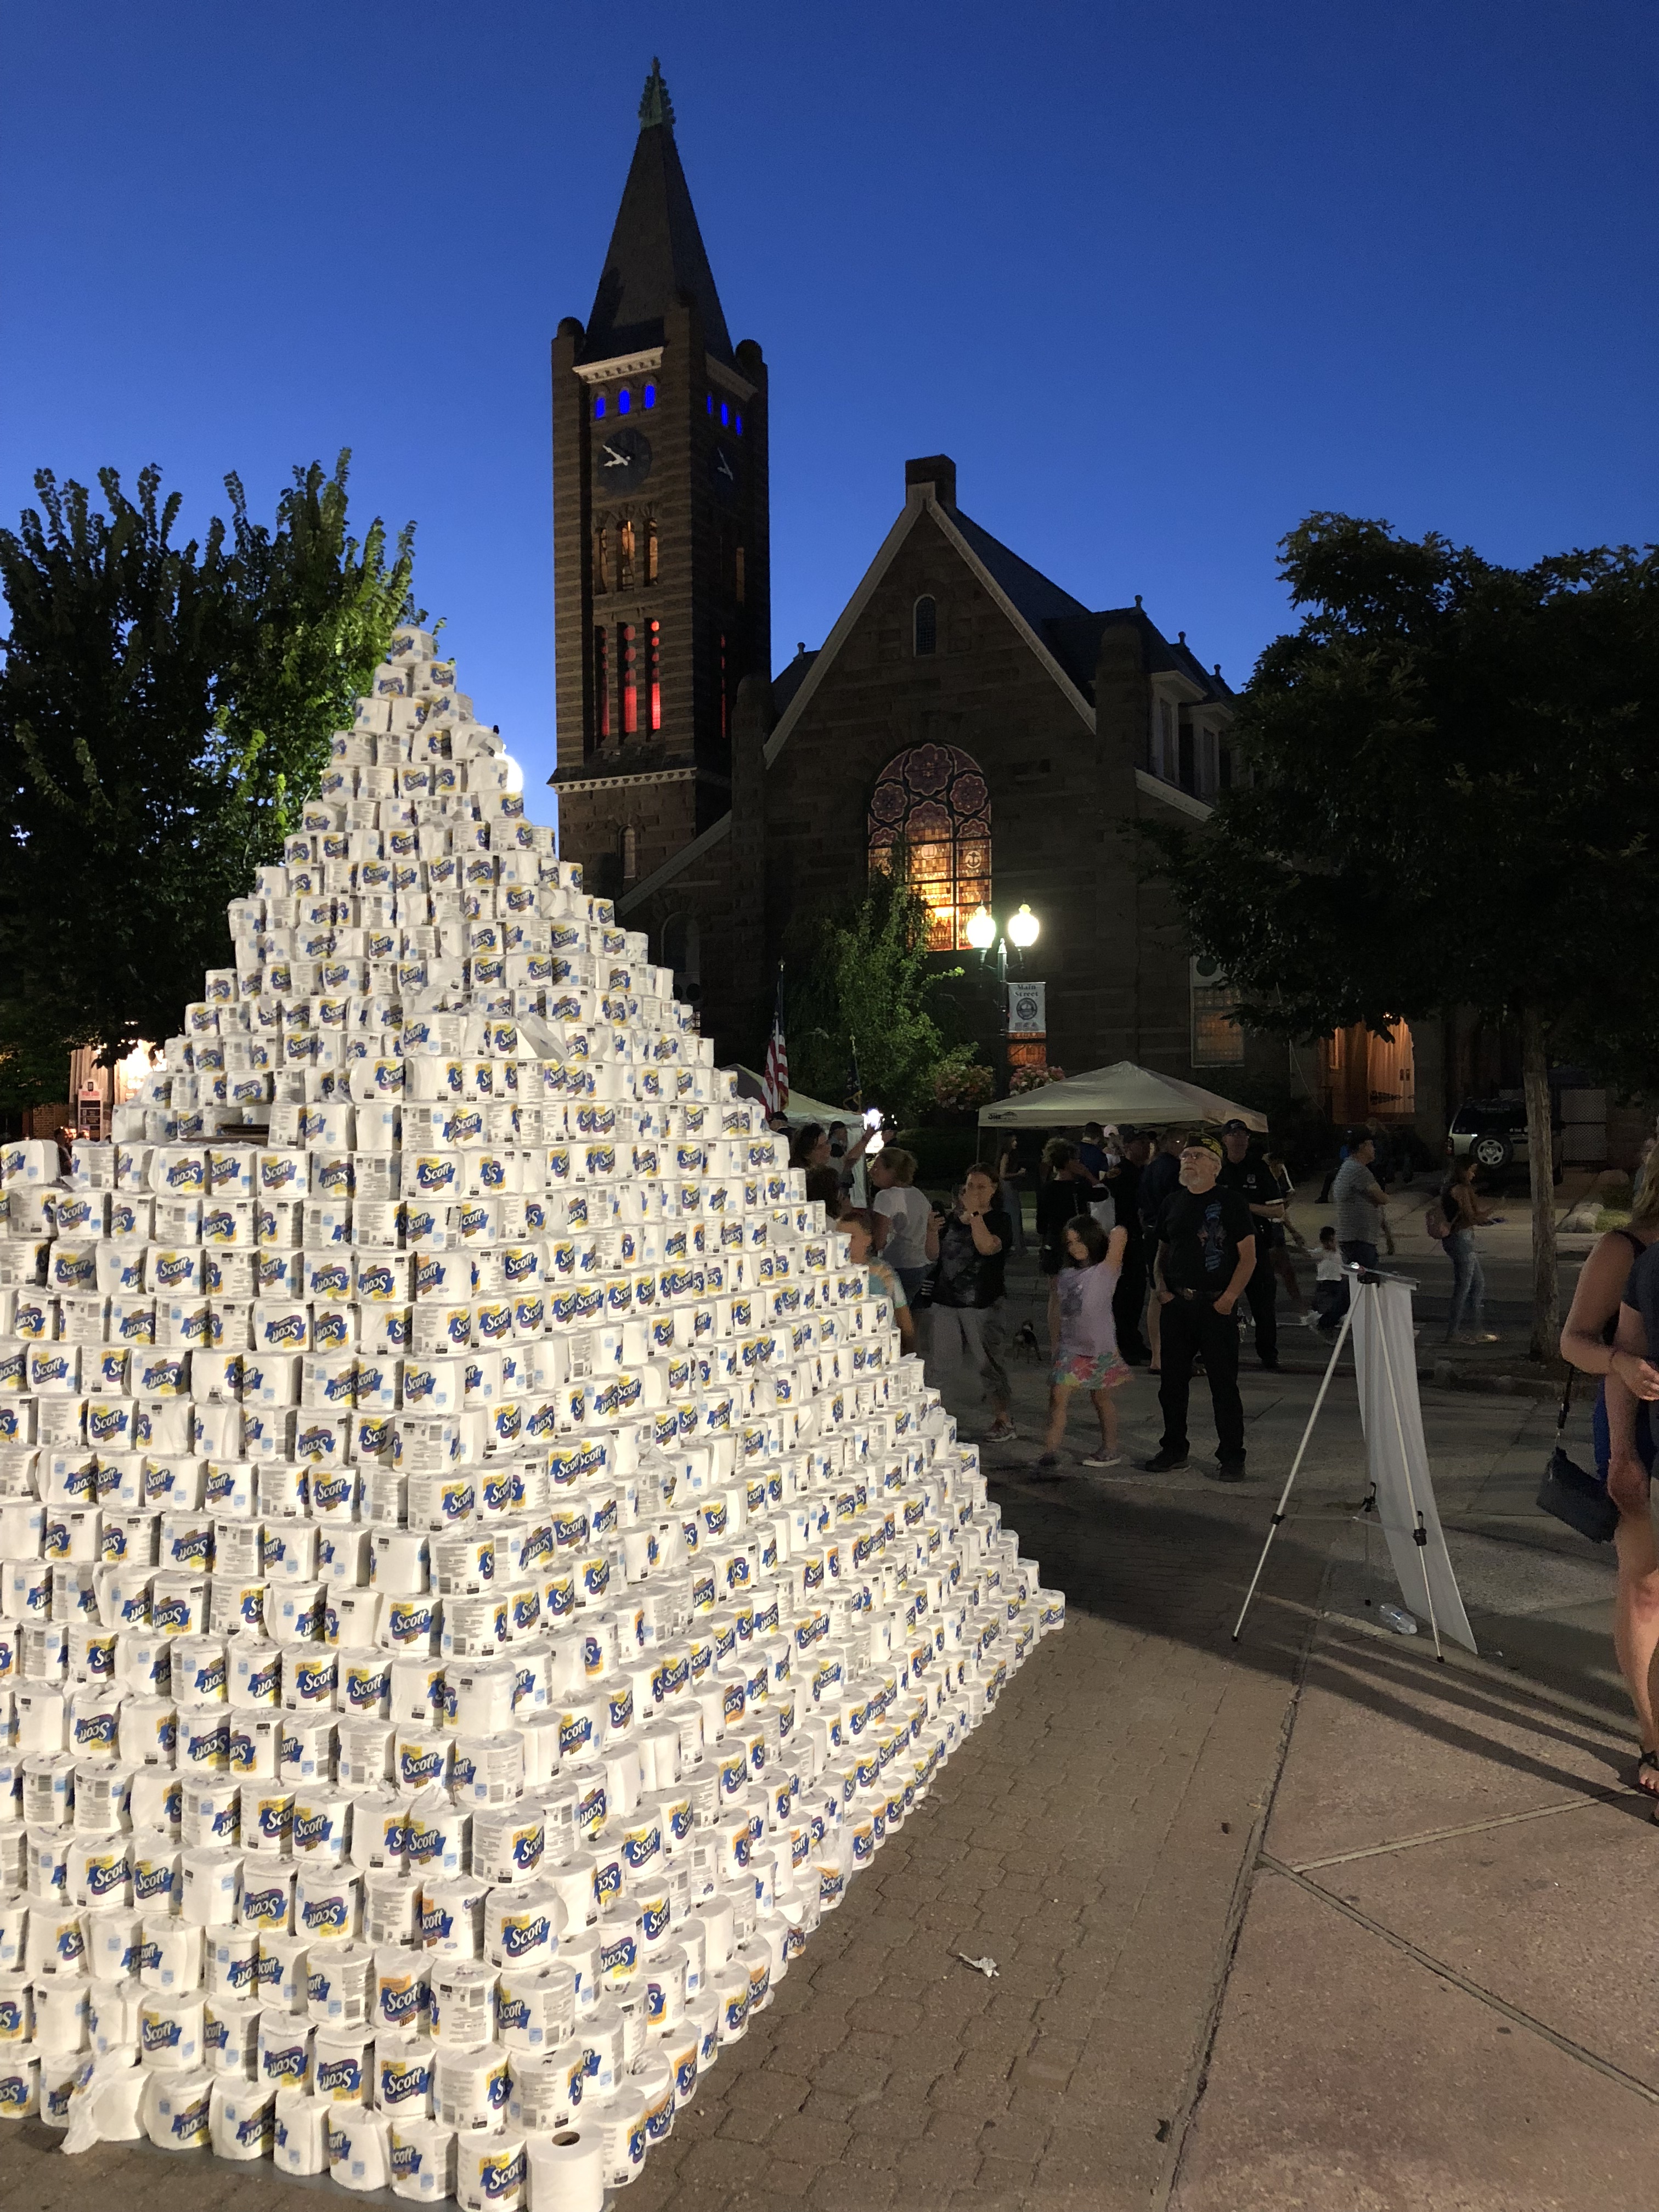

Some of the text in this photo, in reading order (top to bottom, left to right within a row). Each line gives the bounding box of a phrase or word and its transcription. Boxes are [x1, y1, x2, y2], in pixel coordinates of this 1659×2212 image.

[554, 928, 577, 944] Scott
[477, 961, 499, 976] Scott
[455, 1112, 478, 1132] Scott
[173, 1168, 198, 1188] Scott
[212, 1159, 234, 1178] Scott
[263, 1159, 290, 1181] Scott
[323, 1169, 349, 1189] Scott
[423, 1161, 450, 1183] Scott
[59, 1201, 85, 1222] Scott
[462, 1207, 483, 1226] cott
[58, 1257, 87, 1277] Scott
[160, 1257, 189, 1277] Scott
[506, 1252, 535, 1273] Scott
[315, 1273, 343, 1293] Scott
[363, 1274, 388, 1294] Scott
[577, 1288, 603, 1311] Scott
[126, 1319, 153, 1338] Scott
[486, 1307, 511, 1330] Scott
[271, 1321, 300, 1344] Scott
[315, 1322, 340, 1343] Scott
[34, 1359, 62, 1378] Scott
[149, 1369, 178, 1389] Scott
[671, 1362, 689, 1380] cott
[407, 1372, 430, 1391] Scott
[618, 1378, 640, 1398] Scott
[94, 1409, 121, 1431] Scott
[533, 1412, 554, 1436] Scott
[656, 1417, 676, 1439] Scott
[300, 1436, 329, 1457] Scott
[746, 1430, 763, 1448] cott
[560, 1454, 580, 1478] Scott
[580, 1445, 603, 1466] Scott
[147, 1469, 170, 1488] Scott
[207, 1473, 229, 1492] Scott
[317, 1479, 345, 1500] Scott
[452, 1486, 472, 1512] Scott
[748, 1484, 764, 1503] cott
[558, 1514, 585, 1540] Scott
[178, 1539, 207, 1561] Scott
[155, 1607, 183, 1626] Scott
[394, 1609, 427, 1632] Scott
[692, 1646, 711, 1668] cott
[303, 1666, 336, 1691] Scott
[665, 1658, 690, 1686] Scott
[353, 1674, 384, 1697] Scott
[79, 1722, 110, 1742] Scott
[561, 1717, 586, 1743] Scott
[194, 1735, 228, 1760] Scott
[404, 1753, 437, 1776] Scott
[580, 1795, 605, 1829] Scott
[296, 1816, 325, 1838] Scott
[409, 1829, 438, 1851] Scott
[633, 1827, 658, 1860] Scott
[138, 1867, 166, 1891] Scott
[247, 1897, 279, 1918] Scott
[307, 1905, 341, 1927] Scott
[423, 1909, 443, 1929] cott
[509, 1916, 546, 1949] Scott
[386, 1983, 424, 2012] Scott
[498, 1998, 524, 2021] Scott
[144, 2019, 171, 2042] Scott
[269, 2056, 299, 2078] Scott
[321, 2068, 354, 2090] Scott
[386, 2068, 421, 2095] Scott
[393, 2146, 414, 2165] cott
